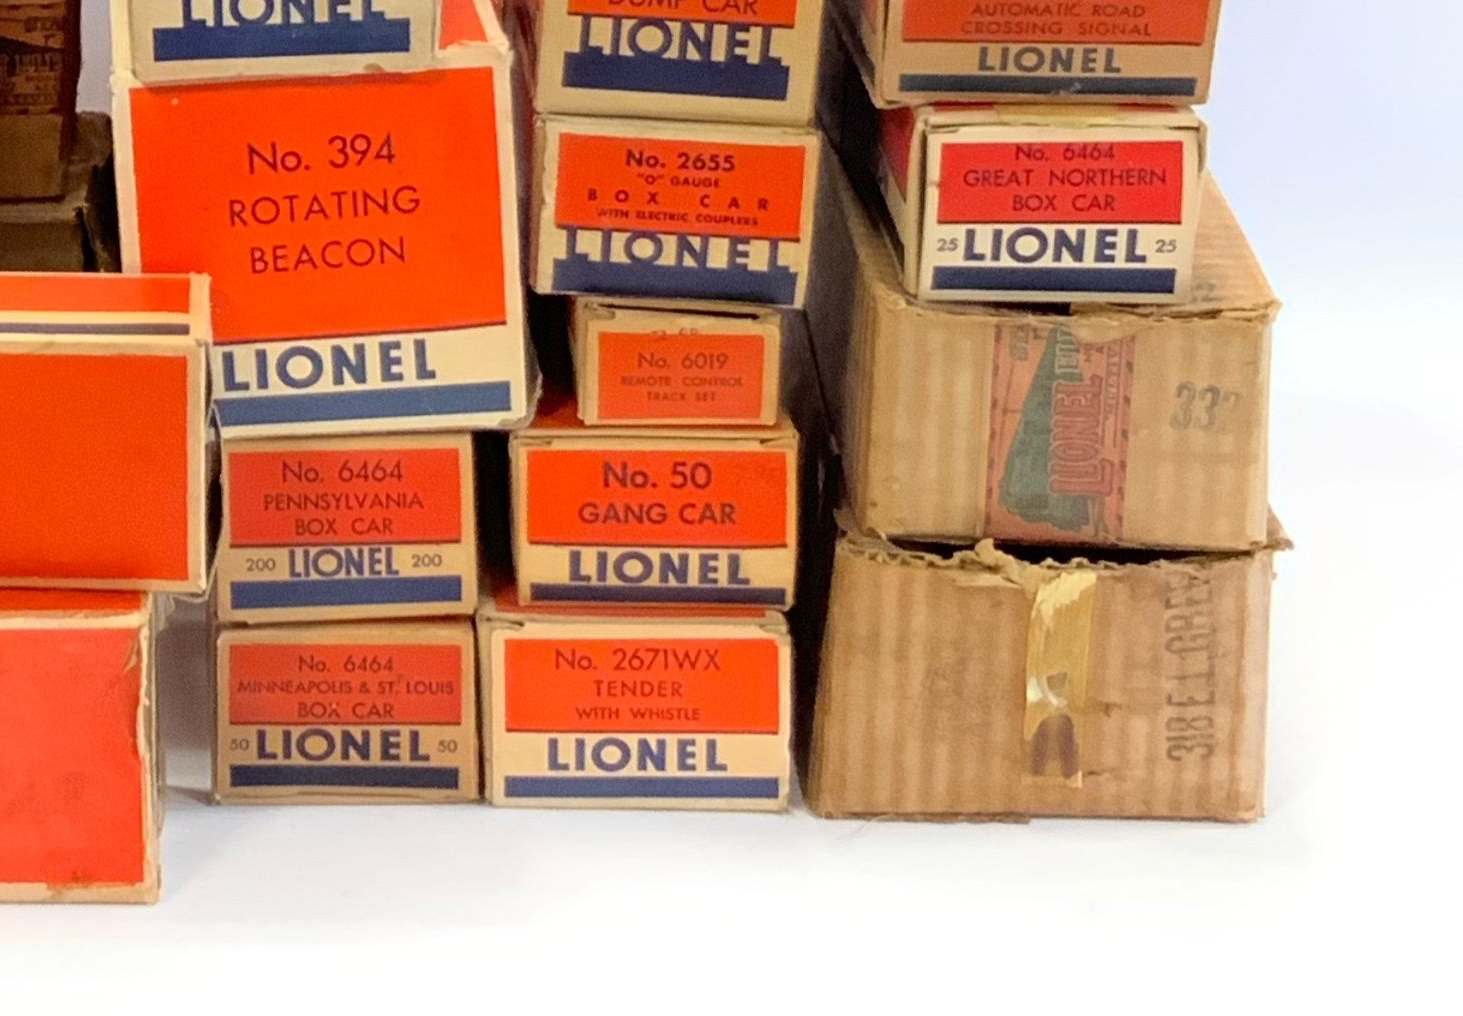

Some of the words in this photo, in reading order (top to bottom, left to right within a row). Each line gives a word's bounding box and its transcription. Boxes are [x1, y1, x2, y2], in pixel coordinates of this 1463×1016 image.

[970, 2, 1081, 17] AUTOMATIC
[1092, 4, 1146, 18] ROAD
[961, 21, 1063, 35] CROSSING
[1078, 22, 1152, 37] SIGNAL
[580, 14, 782, 68] LIONEL
[978, 46, 1122, 73] LIONEL
[248, 142, 311, 175] No.
[327, 132, 396, 169] 394
[626, 149, 666, 168] No.
[677, 152, 736, 172] 2655
[1015, 144, 1049, 161] No.
[1063, 144, 1115, 161] 6464
[670, 176, 720, 188] GAUGE
[963, 169, 1034, 186] GREAT
[1049, 168, 1167, 186] NORTHERN
[229, 185, 421, 227] ROTATING
[1012, 194, 1057, 212] BOX
[1072, 194, 1116, 211] CAR
[636, 210, 689, 223] ELECTRIC
[249, 236, 406, 274] BEACON
[566, 226, 790, 274] LIONEL
[937, 238, 958, 252] 25
[963, 227, 1148, 264] LIONEL
[1155, 239, 1177, 252] 25
[221, 338, 436, 392] LIONEL
[682, 353, 729, 369] 6019
[695, 391, 717, 402] SET
[1049, 375, 1113, 495] LIONEL
[282, 461, 324, 484] No.
[338, 459, 404, 482] 6464
[603, 461, 657, 489] No.
[670, 461, 712, 489] 50
[263, 492, 425, 512] PENNSYLVANIA
[578, 502, 668, 525] GANG
[679, 502, 736, 525] CAR
[294, 517, 337, 535] BOX
[350, 517, 394, 534] CAR
[245, 558, 276, 572] 200
[289, 547, 399, 578] LIONEL
[412, 554, 442, 568] 200
[568, 550, 751, 585] LIONEL
[297, 655, 331, 672] No.
[343, 655, 394, 672] 6464
[554, 648, 598, 671] No.
[612, 648, 721, 671] 2671WX
[237, 680, 352, 695] MINNEAPOLIS
[593, 680, 683, 697] TENDER
[297, 702, 341, 719] BOX
[351, 702, 394, 719] CAR
[575, 707, 620, 721] WITH
[629, 707, 701, 721] WHISTLE
[257, 728, 430, 762] LIONEL
[437, 739, 458, 753] 50
[1166, 715, 1214, 762] 318
[547, 736, 728, 772] LIONEL
